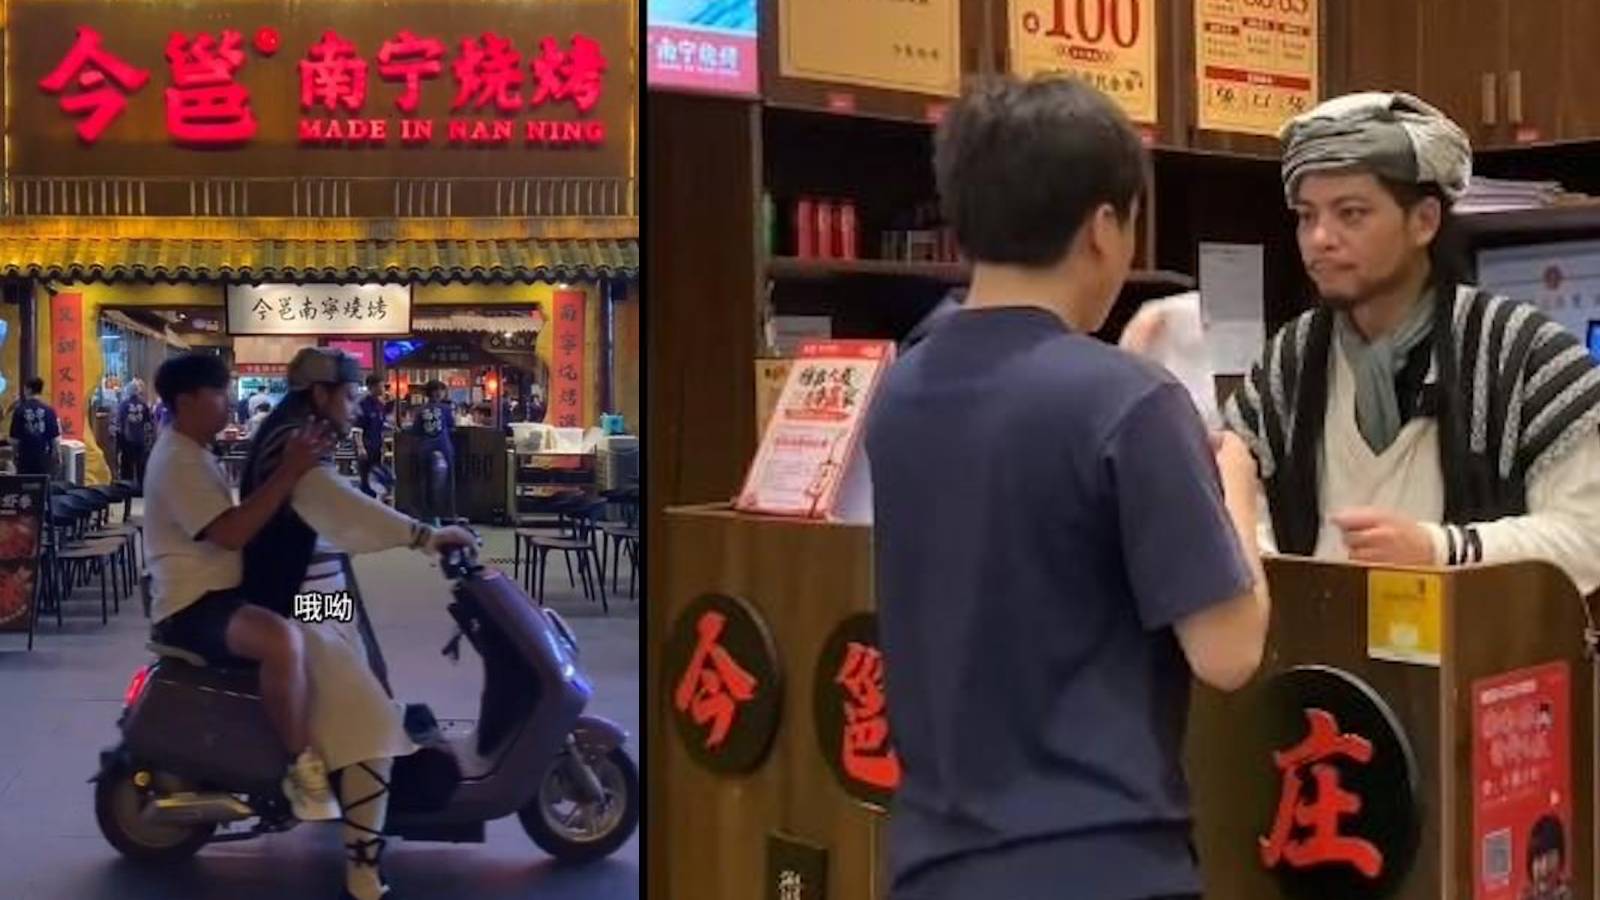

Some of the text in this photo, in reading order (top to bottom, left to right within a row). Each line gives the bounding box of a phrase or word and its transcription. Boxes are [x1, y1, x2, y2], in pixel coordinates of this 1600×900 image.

[39, 25, 607, 144] 今邕 南宁烧烤
[299, 119, 606, 142] MADE IN NAN NING
[676, 610, 757, 748] 今
[1260, 708, 1384, 877] 庄
